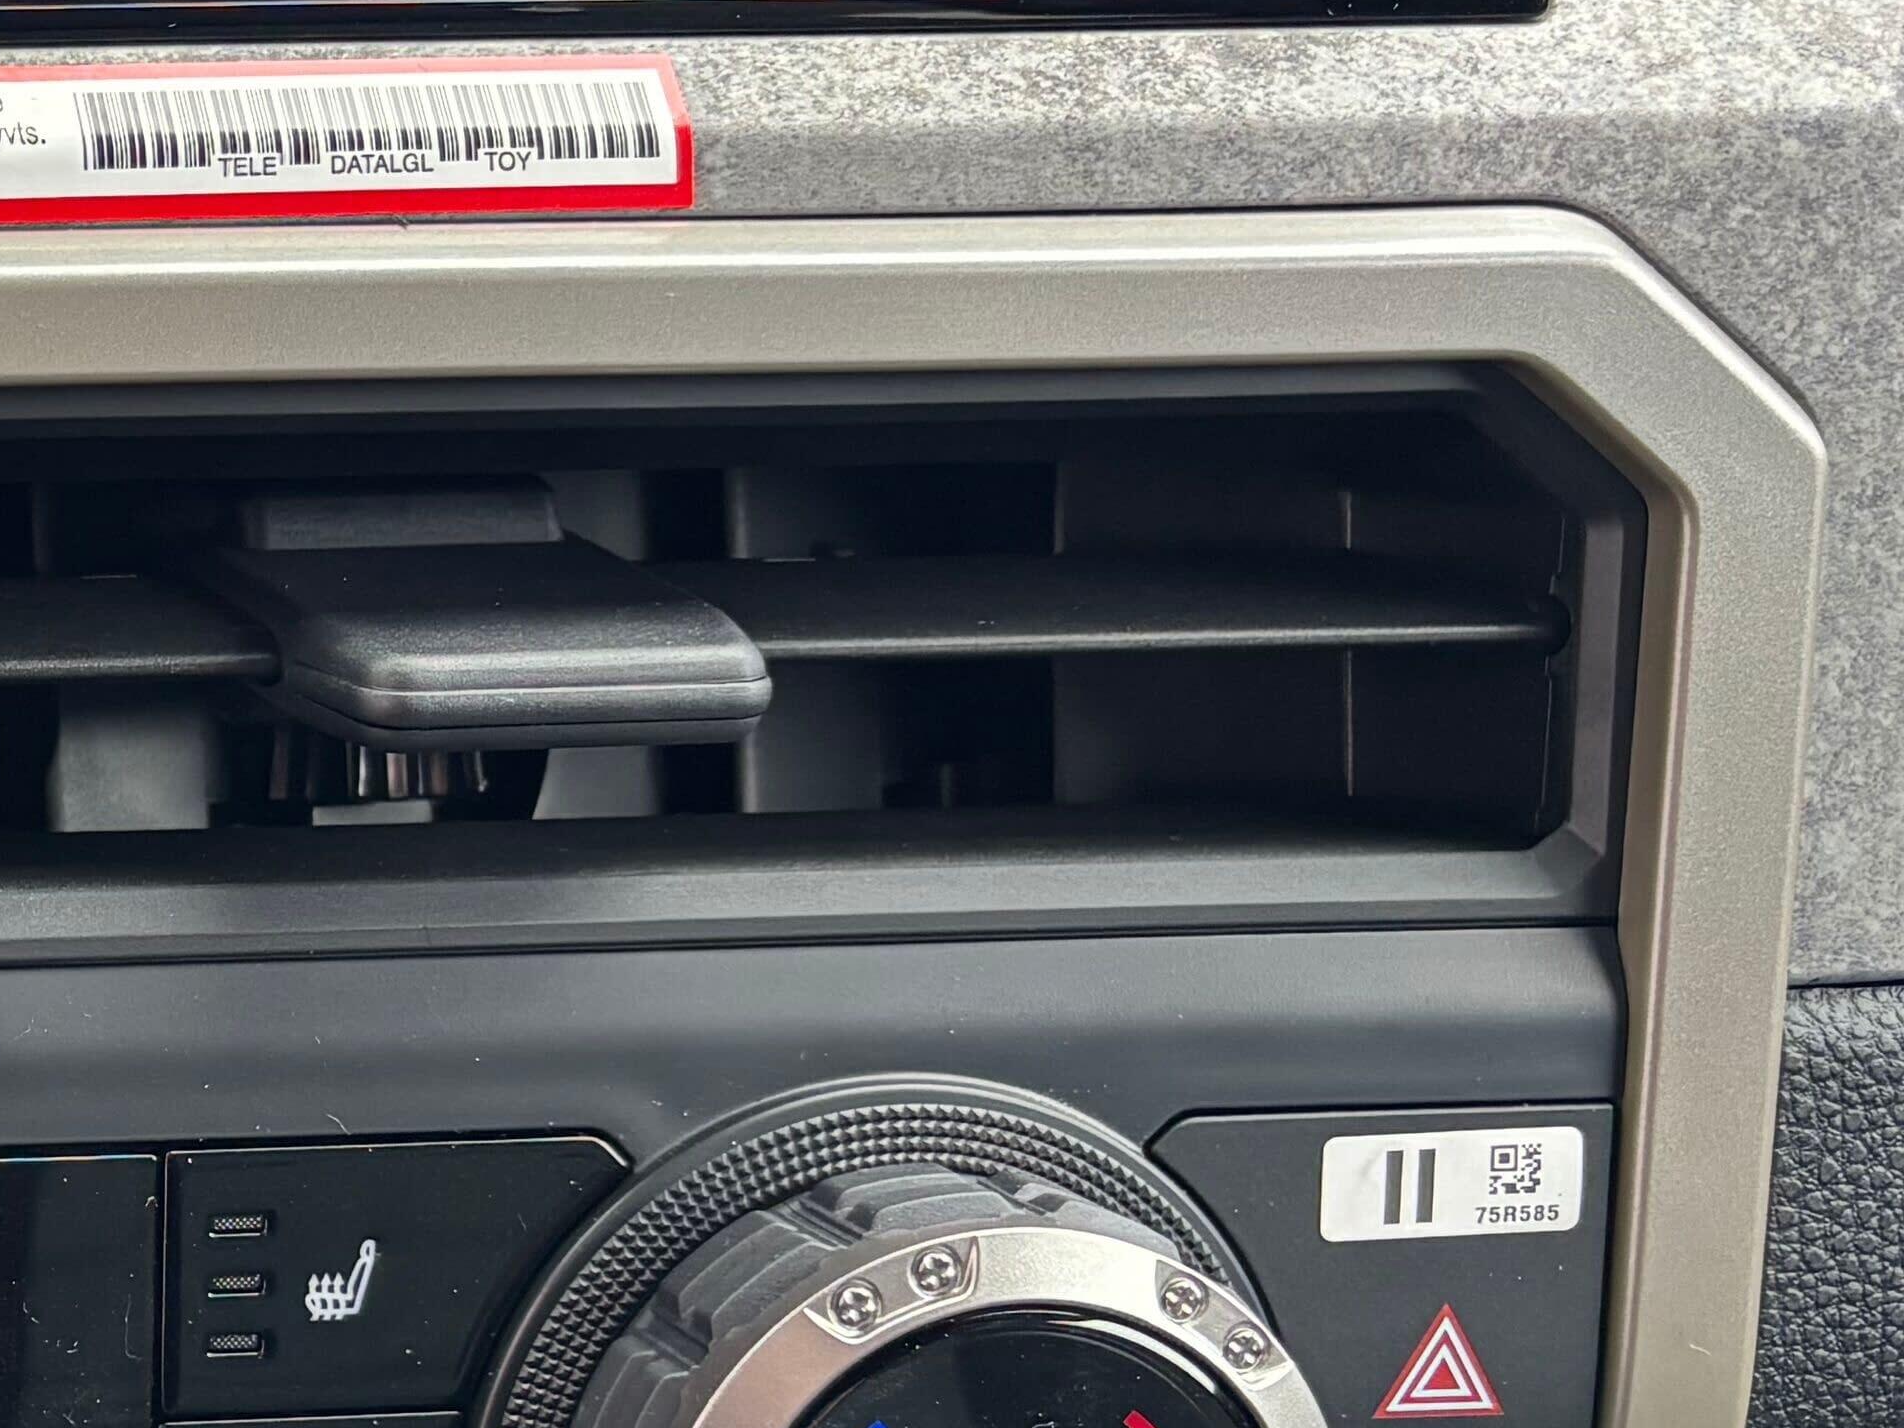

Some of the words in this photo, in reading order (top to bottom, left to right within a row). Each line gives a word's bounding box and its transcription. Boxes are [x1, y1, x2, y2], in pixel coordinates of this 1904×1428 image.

[218, 156, 278, 177] TELE
[331, 152, 434, 174] DATALGL
[484, 151, 532, 172] TOY
[1475, 1204, 1560, 1225] 75R585
